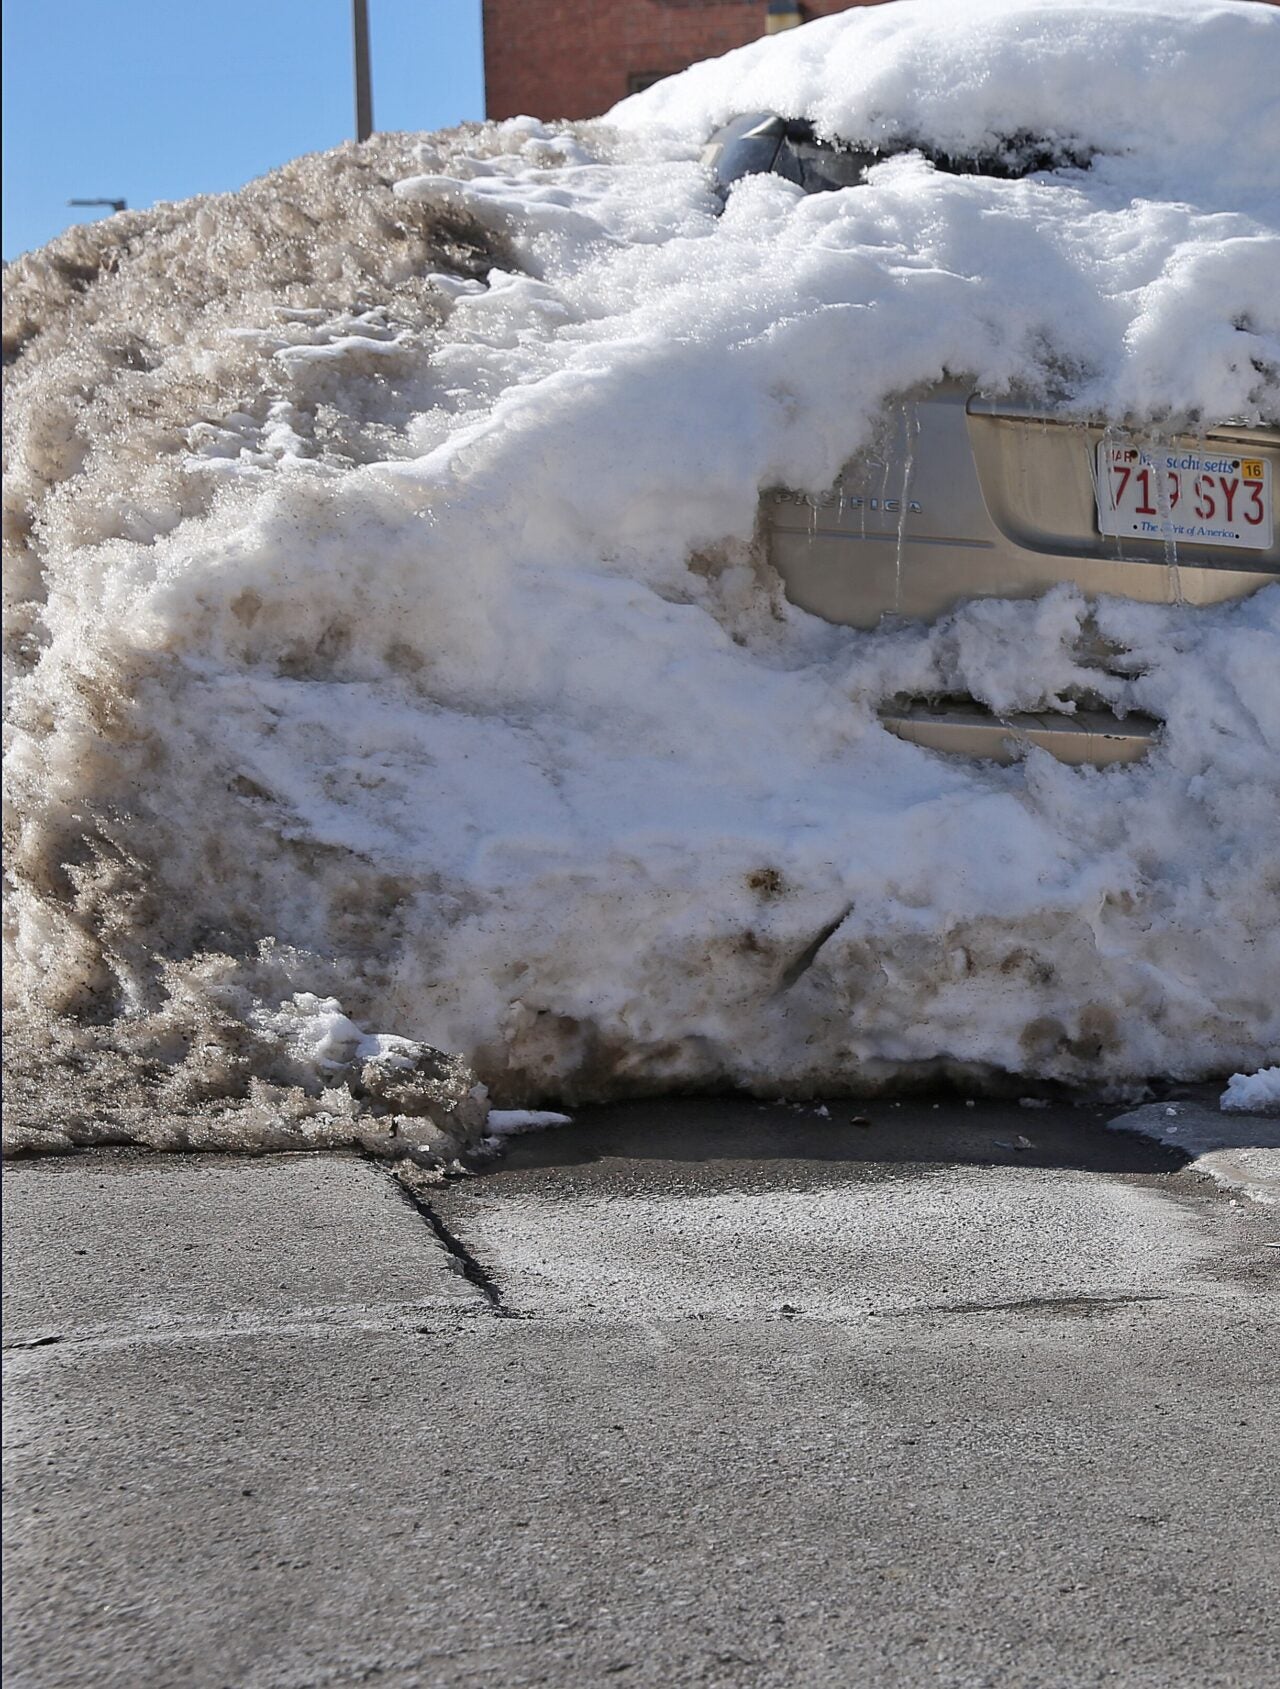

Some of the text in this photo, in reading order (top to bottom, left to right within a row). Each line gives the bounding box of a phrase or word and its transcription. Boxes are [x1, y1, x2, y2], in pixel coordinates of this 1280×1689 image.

[1106, 449, 1132, 463] AR
[1245, 464, 1262, 477] 16
[1194, 475, 1265, 526] SY3
[1141, 521, 1159, 532] The
[1186, 525, 1196, 536] of
